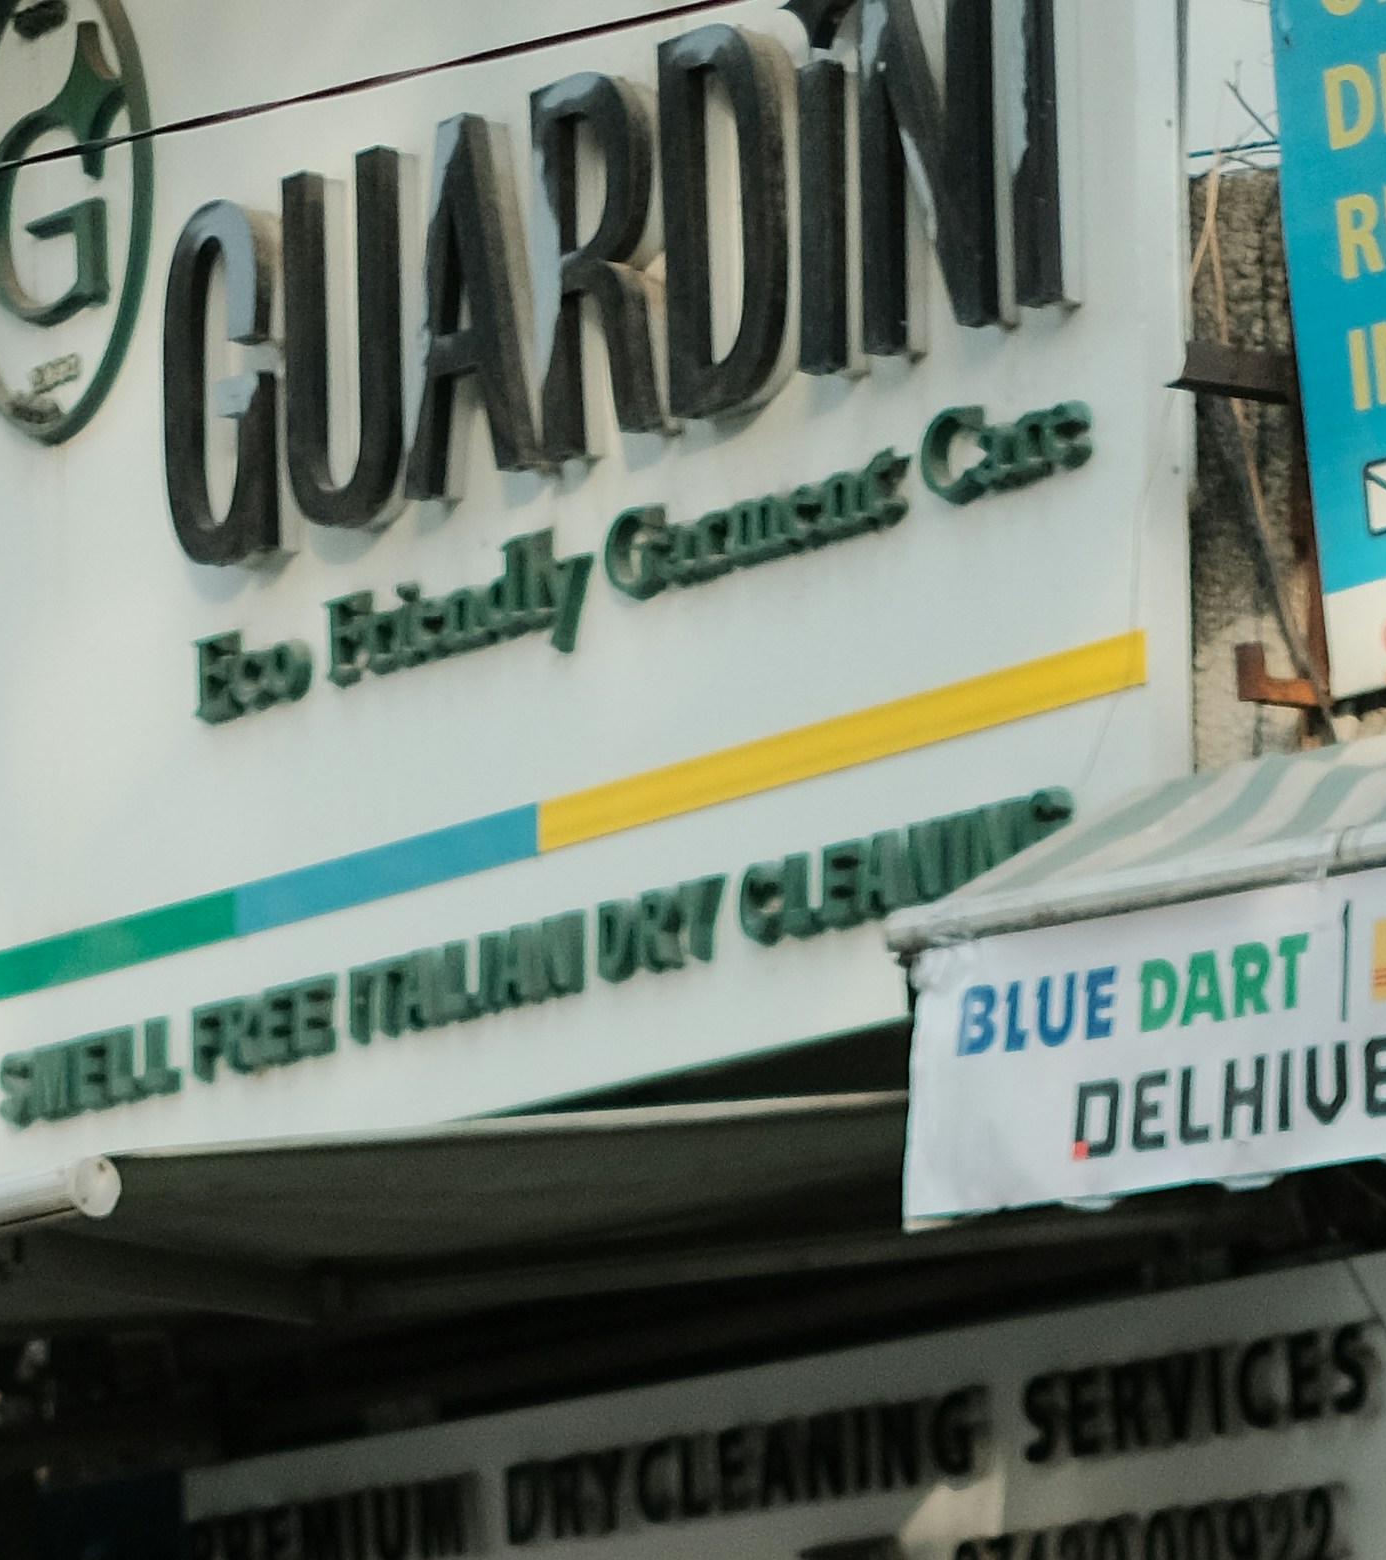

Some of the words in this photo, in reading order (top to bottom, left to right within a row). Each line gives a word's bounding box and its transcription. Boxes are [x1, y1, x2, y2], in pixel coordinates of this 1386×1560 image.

[194, 629, 312, 725] Eco
[324, 526, 594, 689] Friendly
[604, 447, 911, 600] Garment
[921, 400, 1093, 505] Care
[0, 1015, 182, 1127] SMELL
[192, 972, 337, 1083] FREE
[348, 909, 586, 1045] ITALIAN
[597, 872, 727, 984] DRY
[957, 965, 1119, 1057] BLUE
[1139, 932, 1310, 1033] DART
[1023, 1320, 1376, 1465] SERVICES
